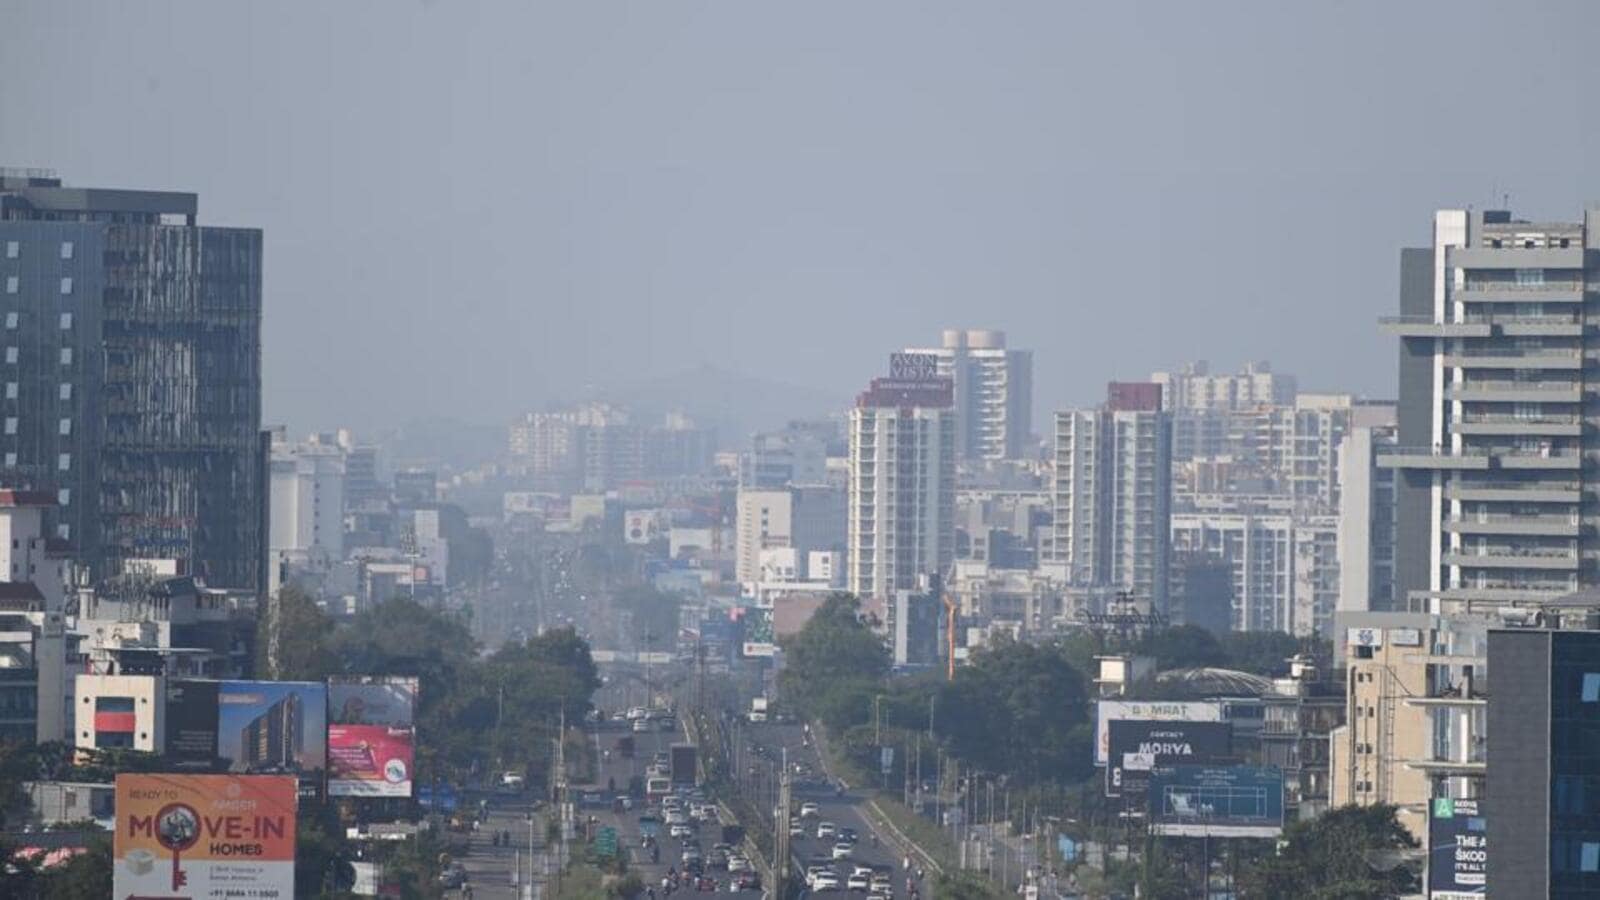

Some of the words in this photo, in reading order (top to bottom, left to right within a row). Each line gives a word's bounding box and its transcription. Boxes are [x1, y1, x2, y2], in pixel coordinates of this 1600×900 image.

[891, 367, 937, 378] VISTA
[1132, 705, 1188, 715] MRAT
[129, 789, 160, 800] READY
[163, 790, 178, 800] TO
[1455, 834, 1477, 847] THE
[210, 844, 262, 856] HOMES
